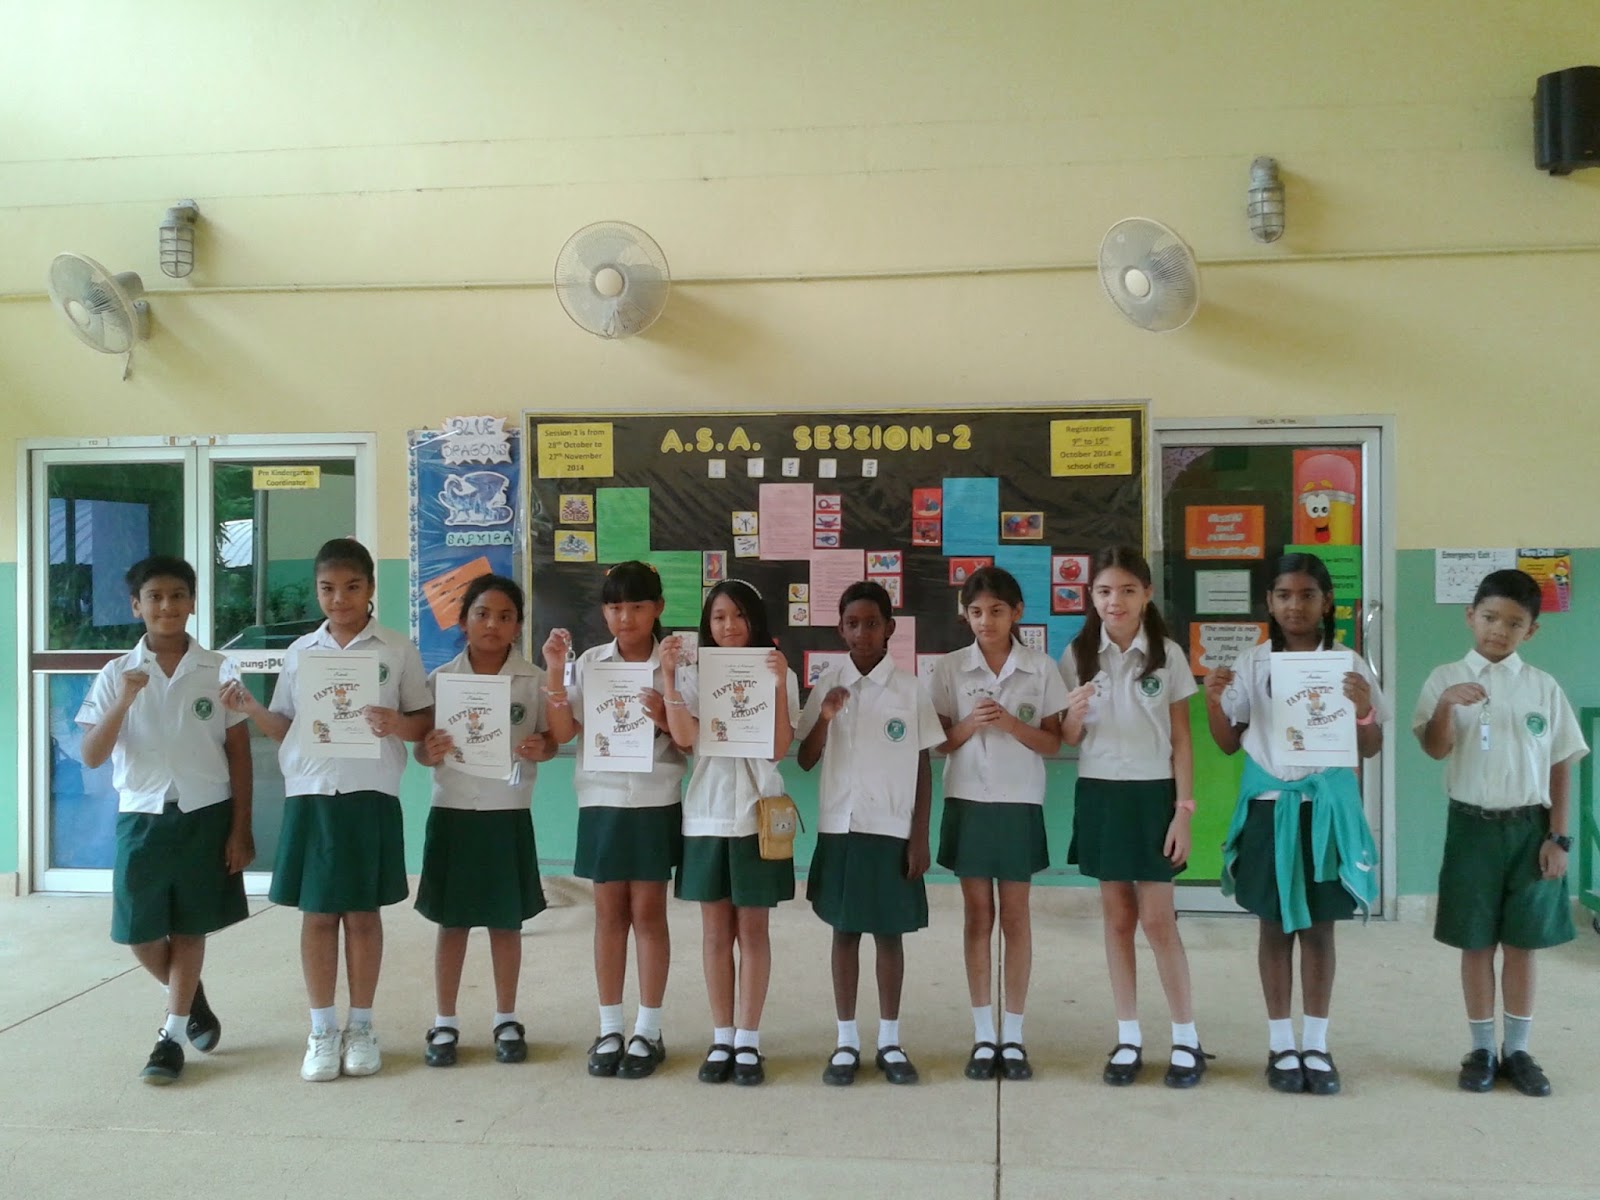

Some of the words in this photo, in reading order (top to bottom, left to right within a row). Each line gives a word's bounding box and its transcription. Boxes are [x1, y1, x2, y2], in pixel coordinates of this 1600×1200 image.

[452, 418, 496, 436] BLUE
[1066, 426, 1114, 434] Registration:
[660, 426, 762, 453] A.S.A.
[792, 424, 972, 451] SESSION-2
[443, 443, 507, 457] DRAGONS
[564, 452, 602, 460] November
[1093, 450, 1112, 458] 2014
[271, 469, 314, 477] Kindergarten
[567, 464, 584, 472] 2014
[1093, 462, 1115, 470] office
[1442, 551, 1476, 561] Emergency
[1478, 550, 1491, 559] Exit
[313, 683, 360, 701] FANTASTIC
[712, 679, 758, 699] FANTASTIC
[1285, 686, 1334, 707] FANTASTIC
[595, 695, 637, 714] FANTASTIC
[447, 706, 492, 725] FANTASTIC
